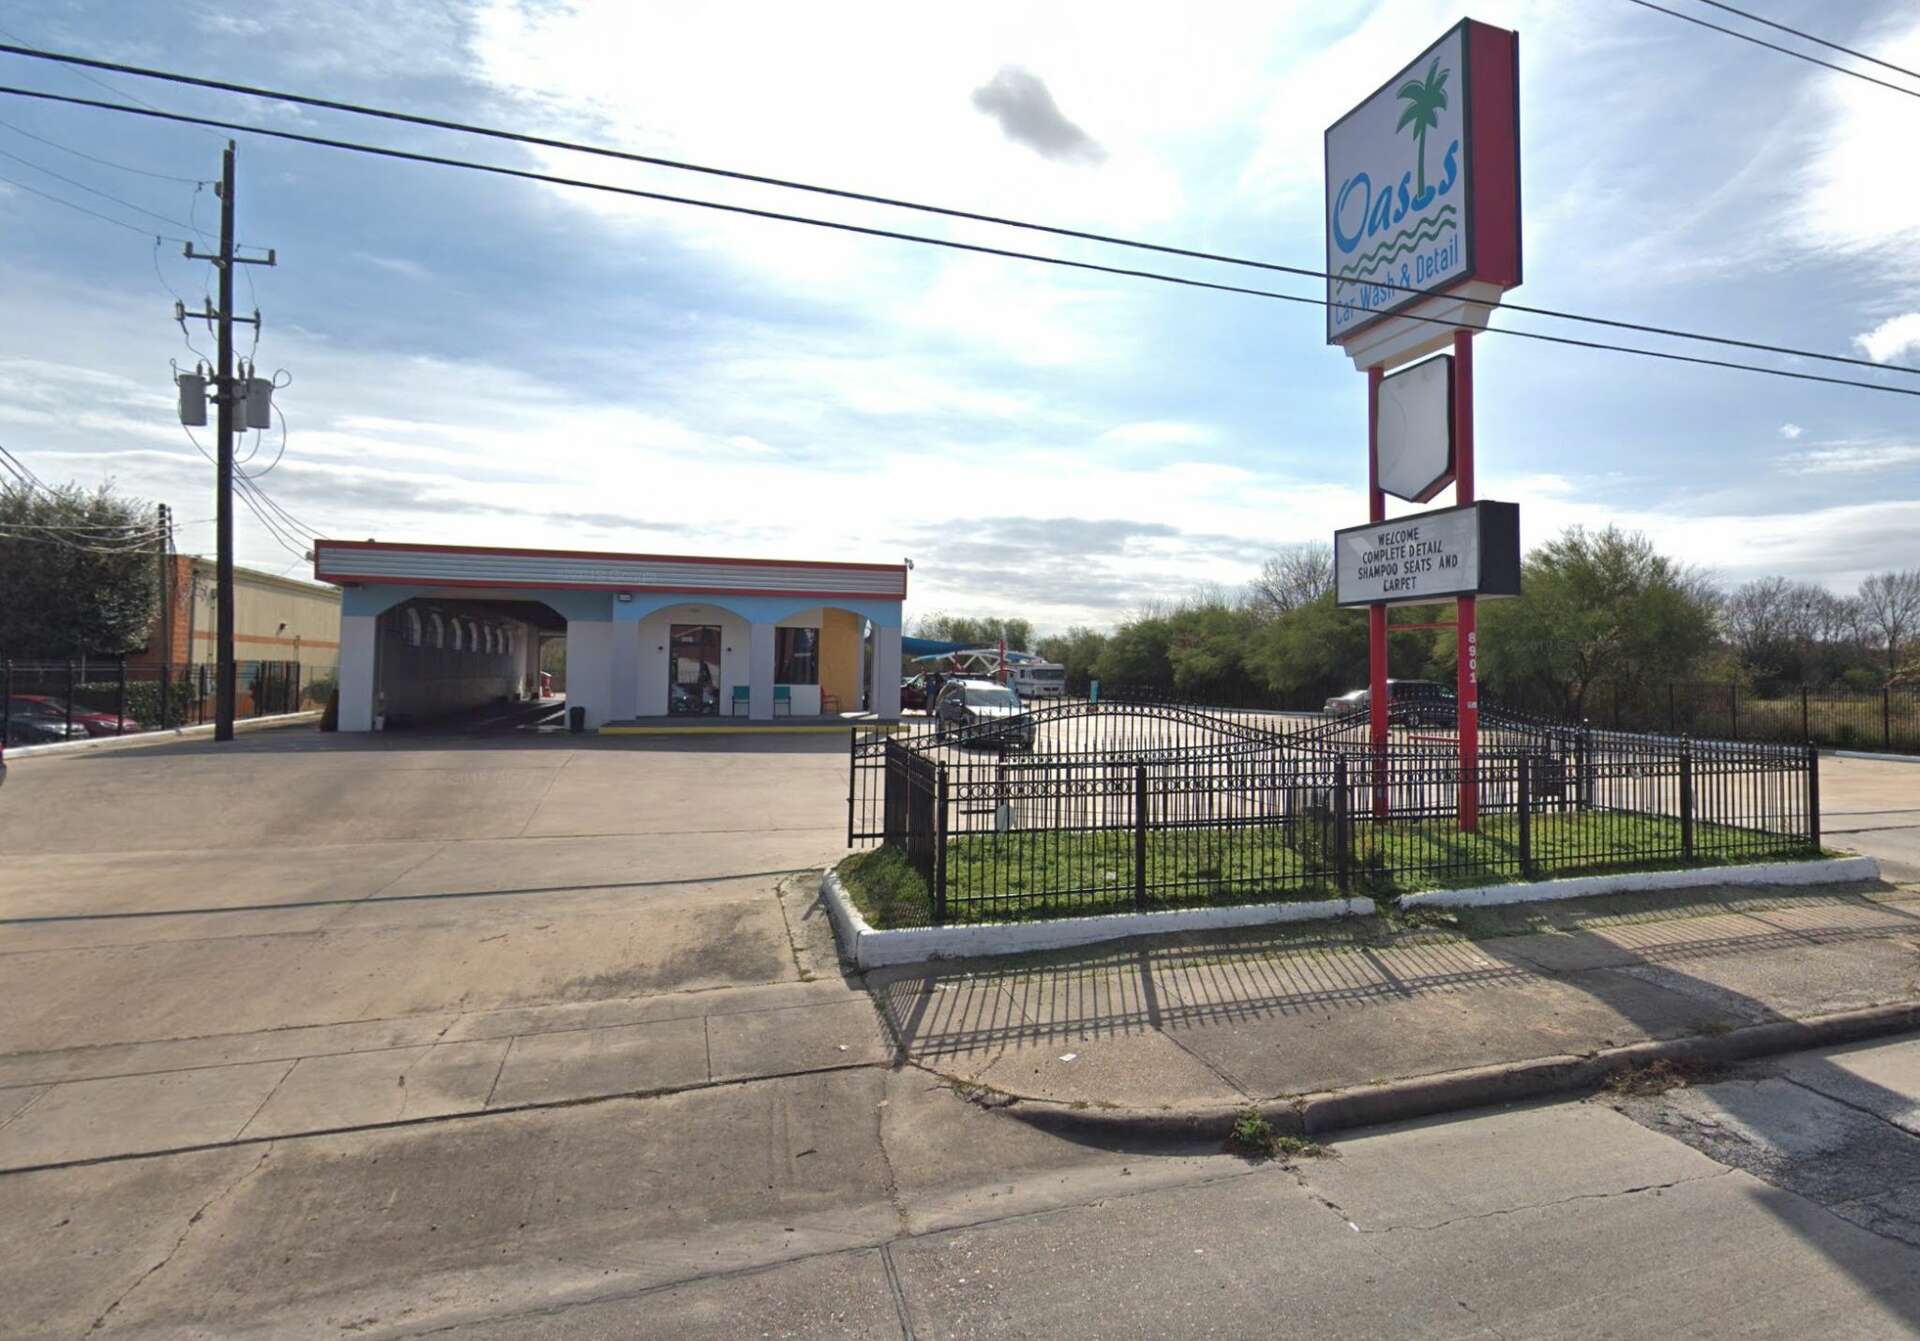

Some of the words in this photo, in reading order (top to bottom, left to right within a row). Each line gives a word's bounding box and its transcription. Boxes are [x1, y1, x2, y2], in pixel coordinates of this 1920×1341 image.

[1333, 139, 1459, 253] Oasis
[1335, 298, 1355, 325] Car
[1360, 271, 1395, 311] Wash
[1401, 263, 1411, 289] &
[1416, 233, 1458, 284] Detail
[1377, 527, 1420, 547] WELCOME
[1362, 546, 1406, 565] COMPLETE
[1408, 540, 1443, 558] DETAIL
[1358, 562, 1399, 580] SHAMPOO
[1403, 559, 1432, 575] SEATS
[1438, 554, 1458, 569] AND
[1383, 576, 1417, 592] CARPET
